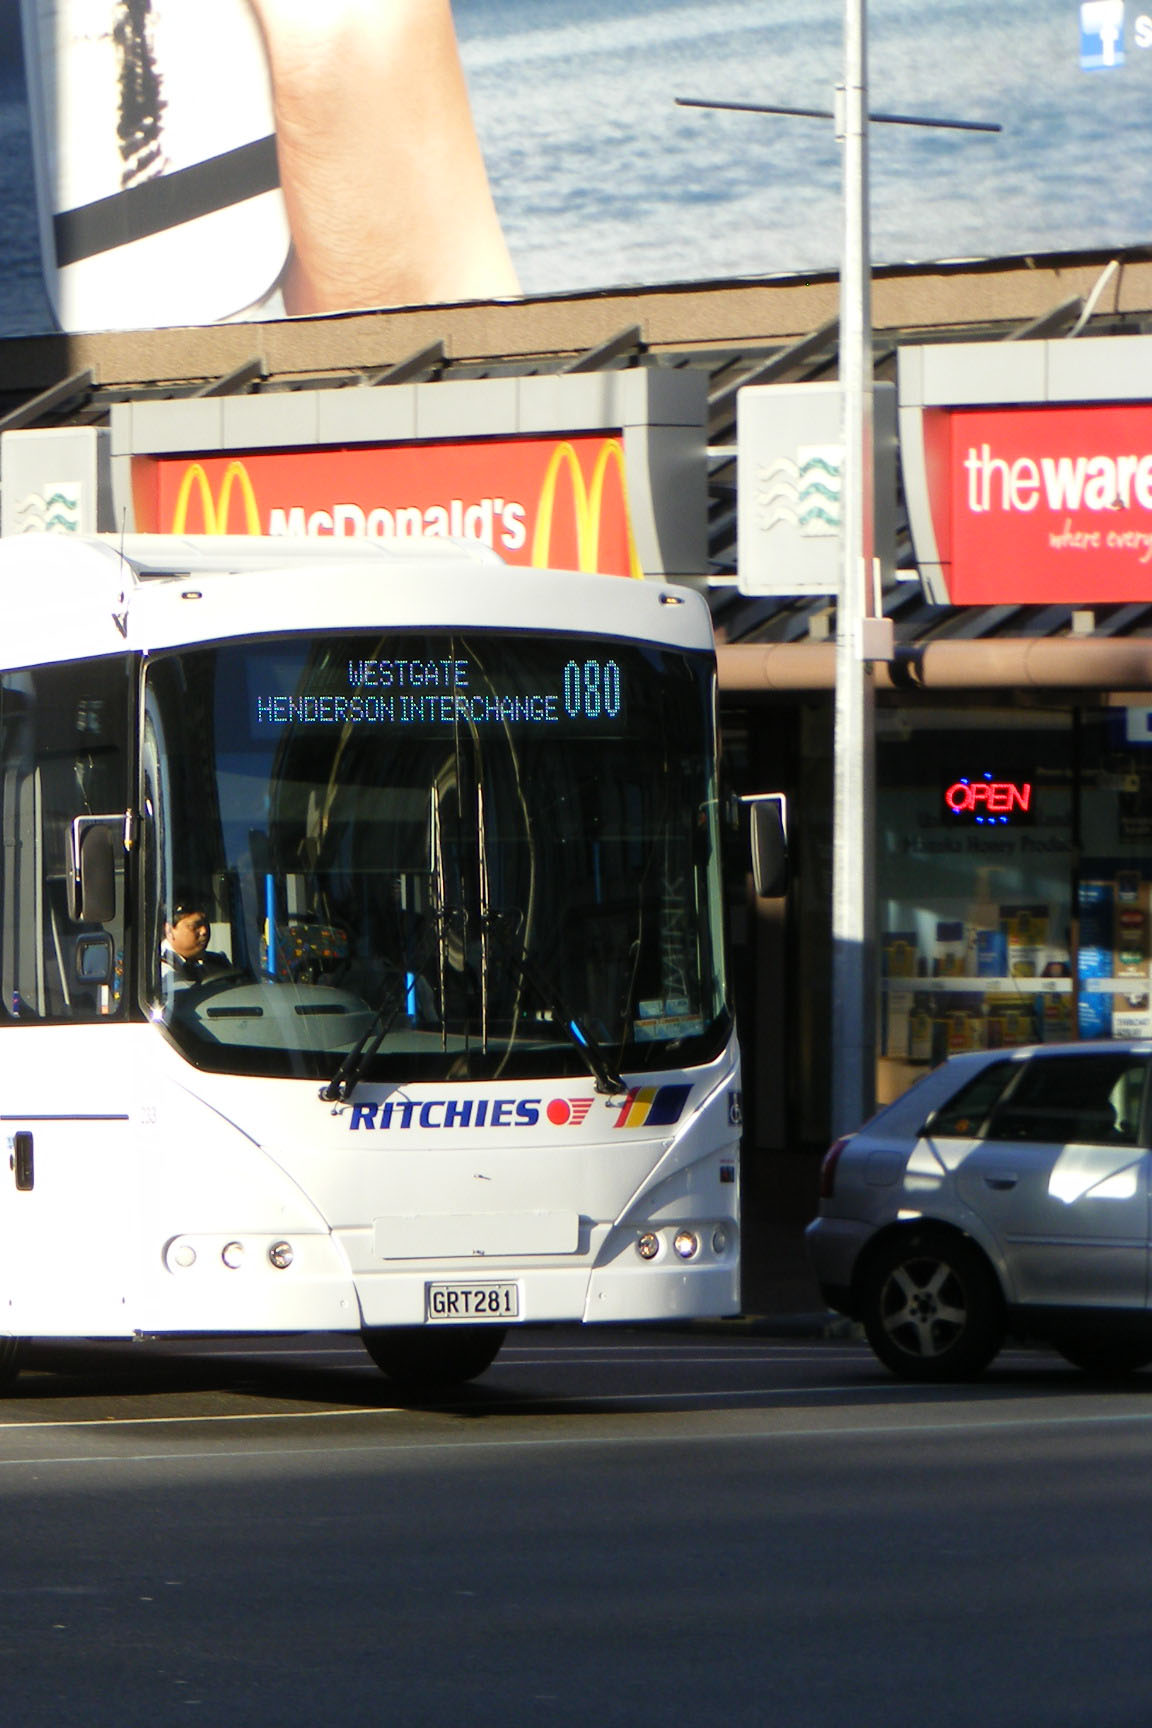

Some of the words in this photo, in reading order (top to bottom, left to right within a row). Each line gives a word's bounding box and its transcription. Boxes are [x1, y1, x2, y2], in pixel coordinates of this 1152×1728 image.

[269, 498, 526, 550] McDonald's
[1049, 517, 1101, 549] where
[1107, 529, 1152, 563] every
[348, 660, 469, 687] WESTGATE
[563, 659, 621, 717] 080
[257, 696, 394, 722] HENDERSON
[400, 696, 559, 721] INTERCHANGE
[945, 783, 1031, 811] OPEN
[349, 1098, 542, 1130] RITCHIES
[431, 1290, 512, 1315] GRT281
